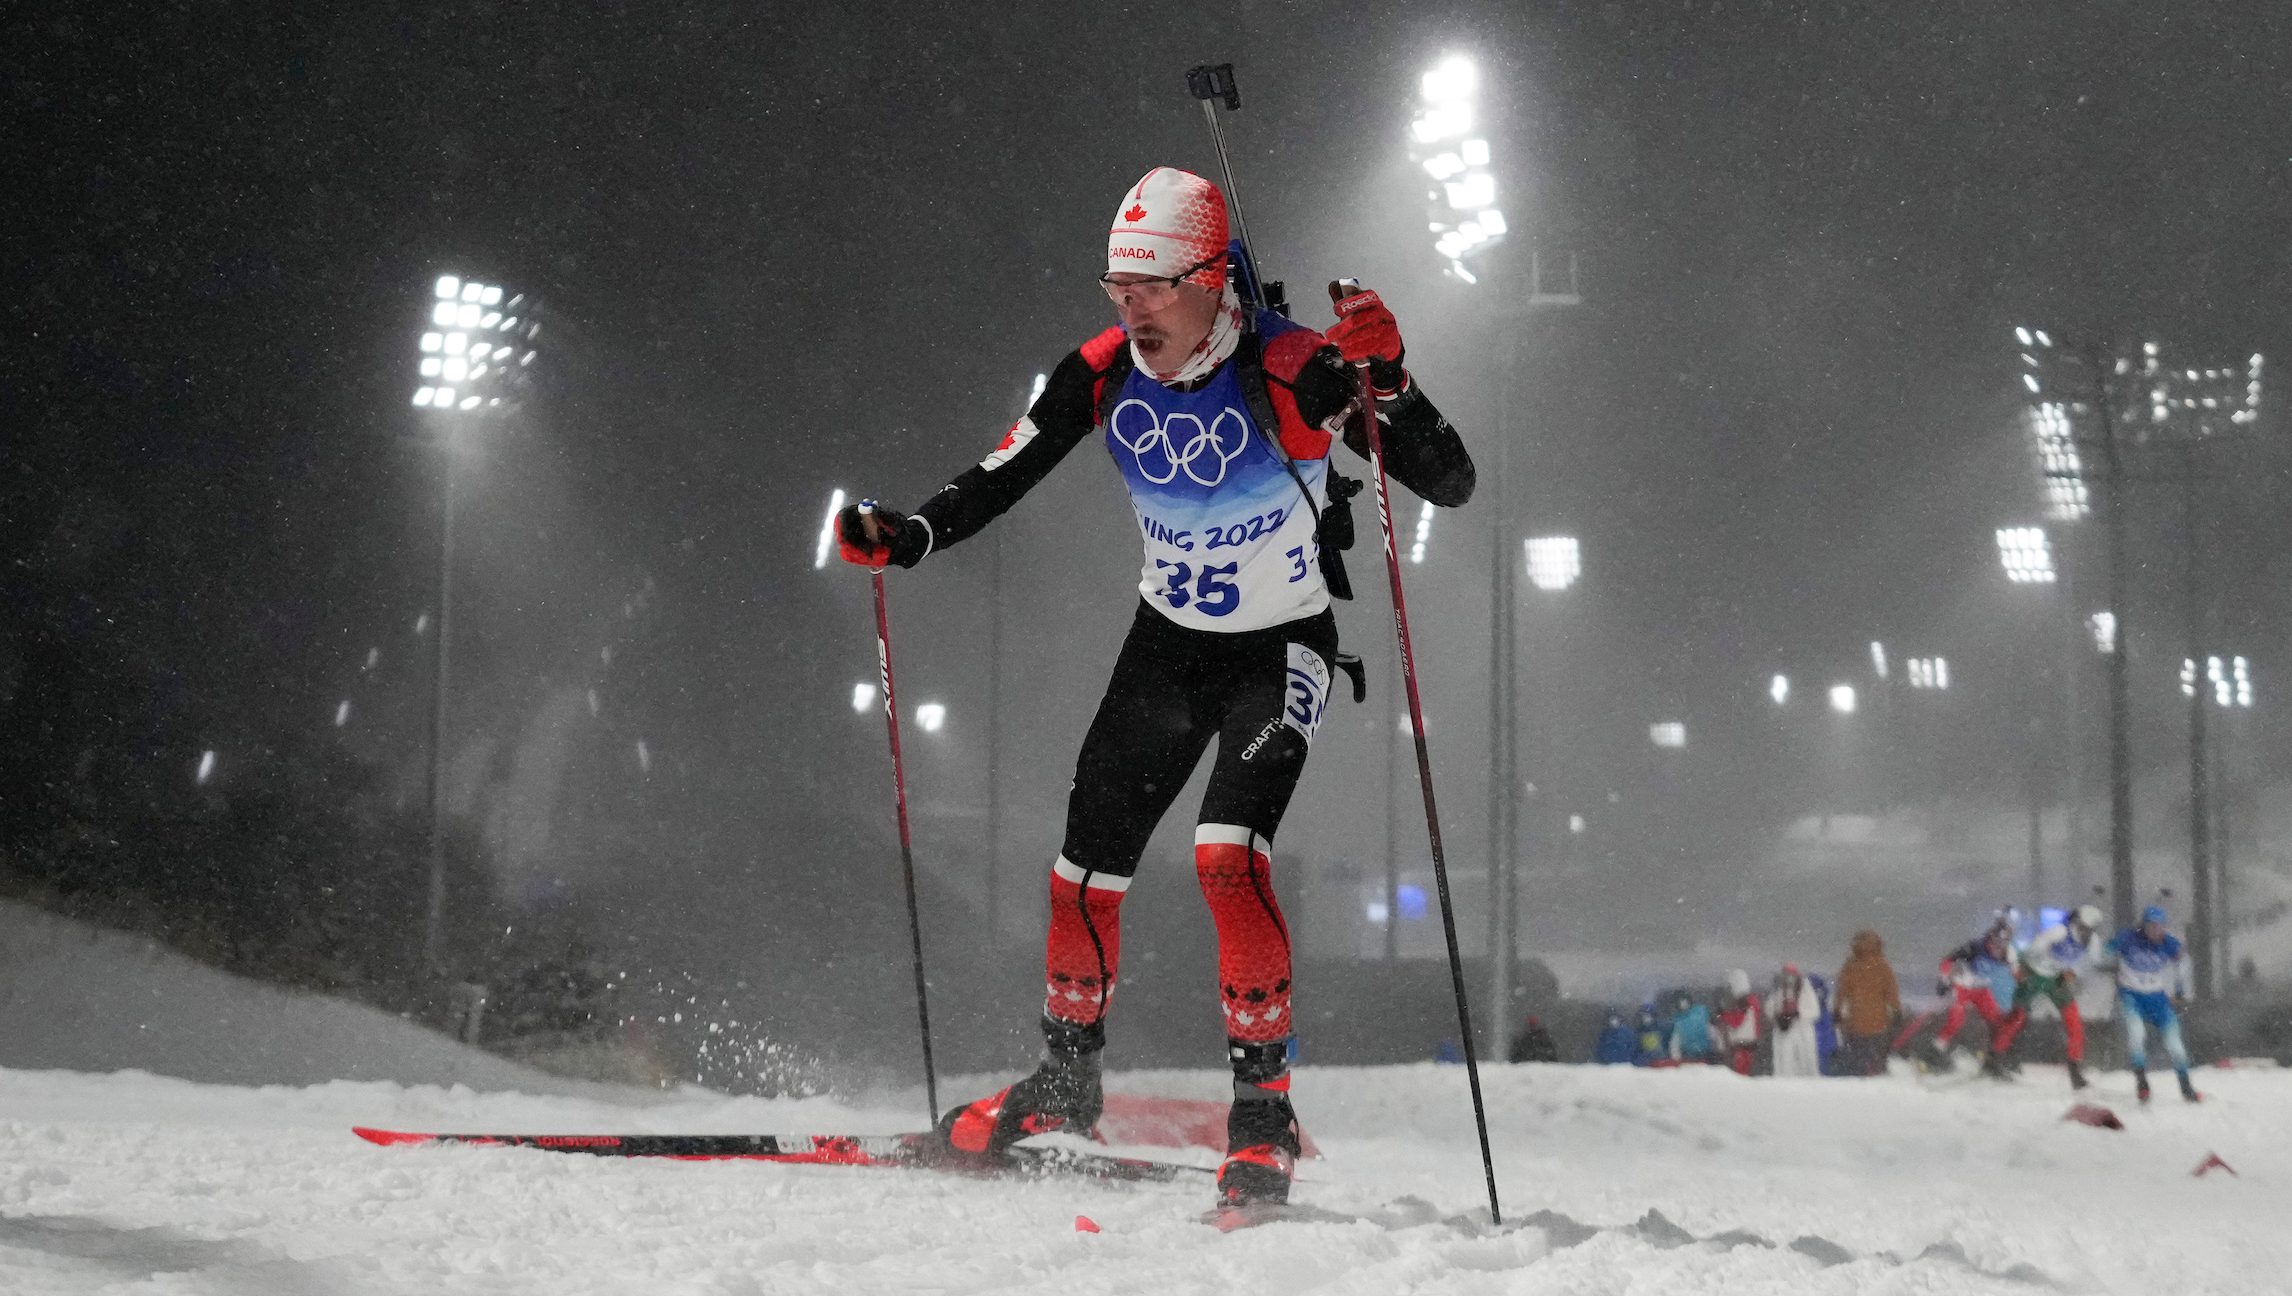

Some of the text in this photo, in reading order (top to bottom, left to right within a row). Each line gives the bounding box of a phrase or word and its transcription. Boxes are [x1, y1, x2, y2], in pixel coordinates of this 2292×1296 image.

[1109, 248, 1156, 261] CANADA
[1205, 508, 1284, 550] 2022
[1285, 545, 1318, 583] 3
[1156, 558, 1240, 617] 35
[1241, 722, 1277, 761] CRAFT
